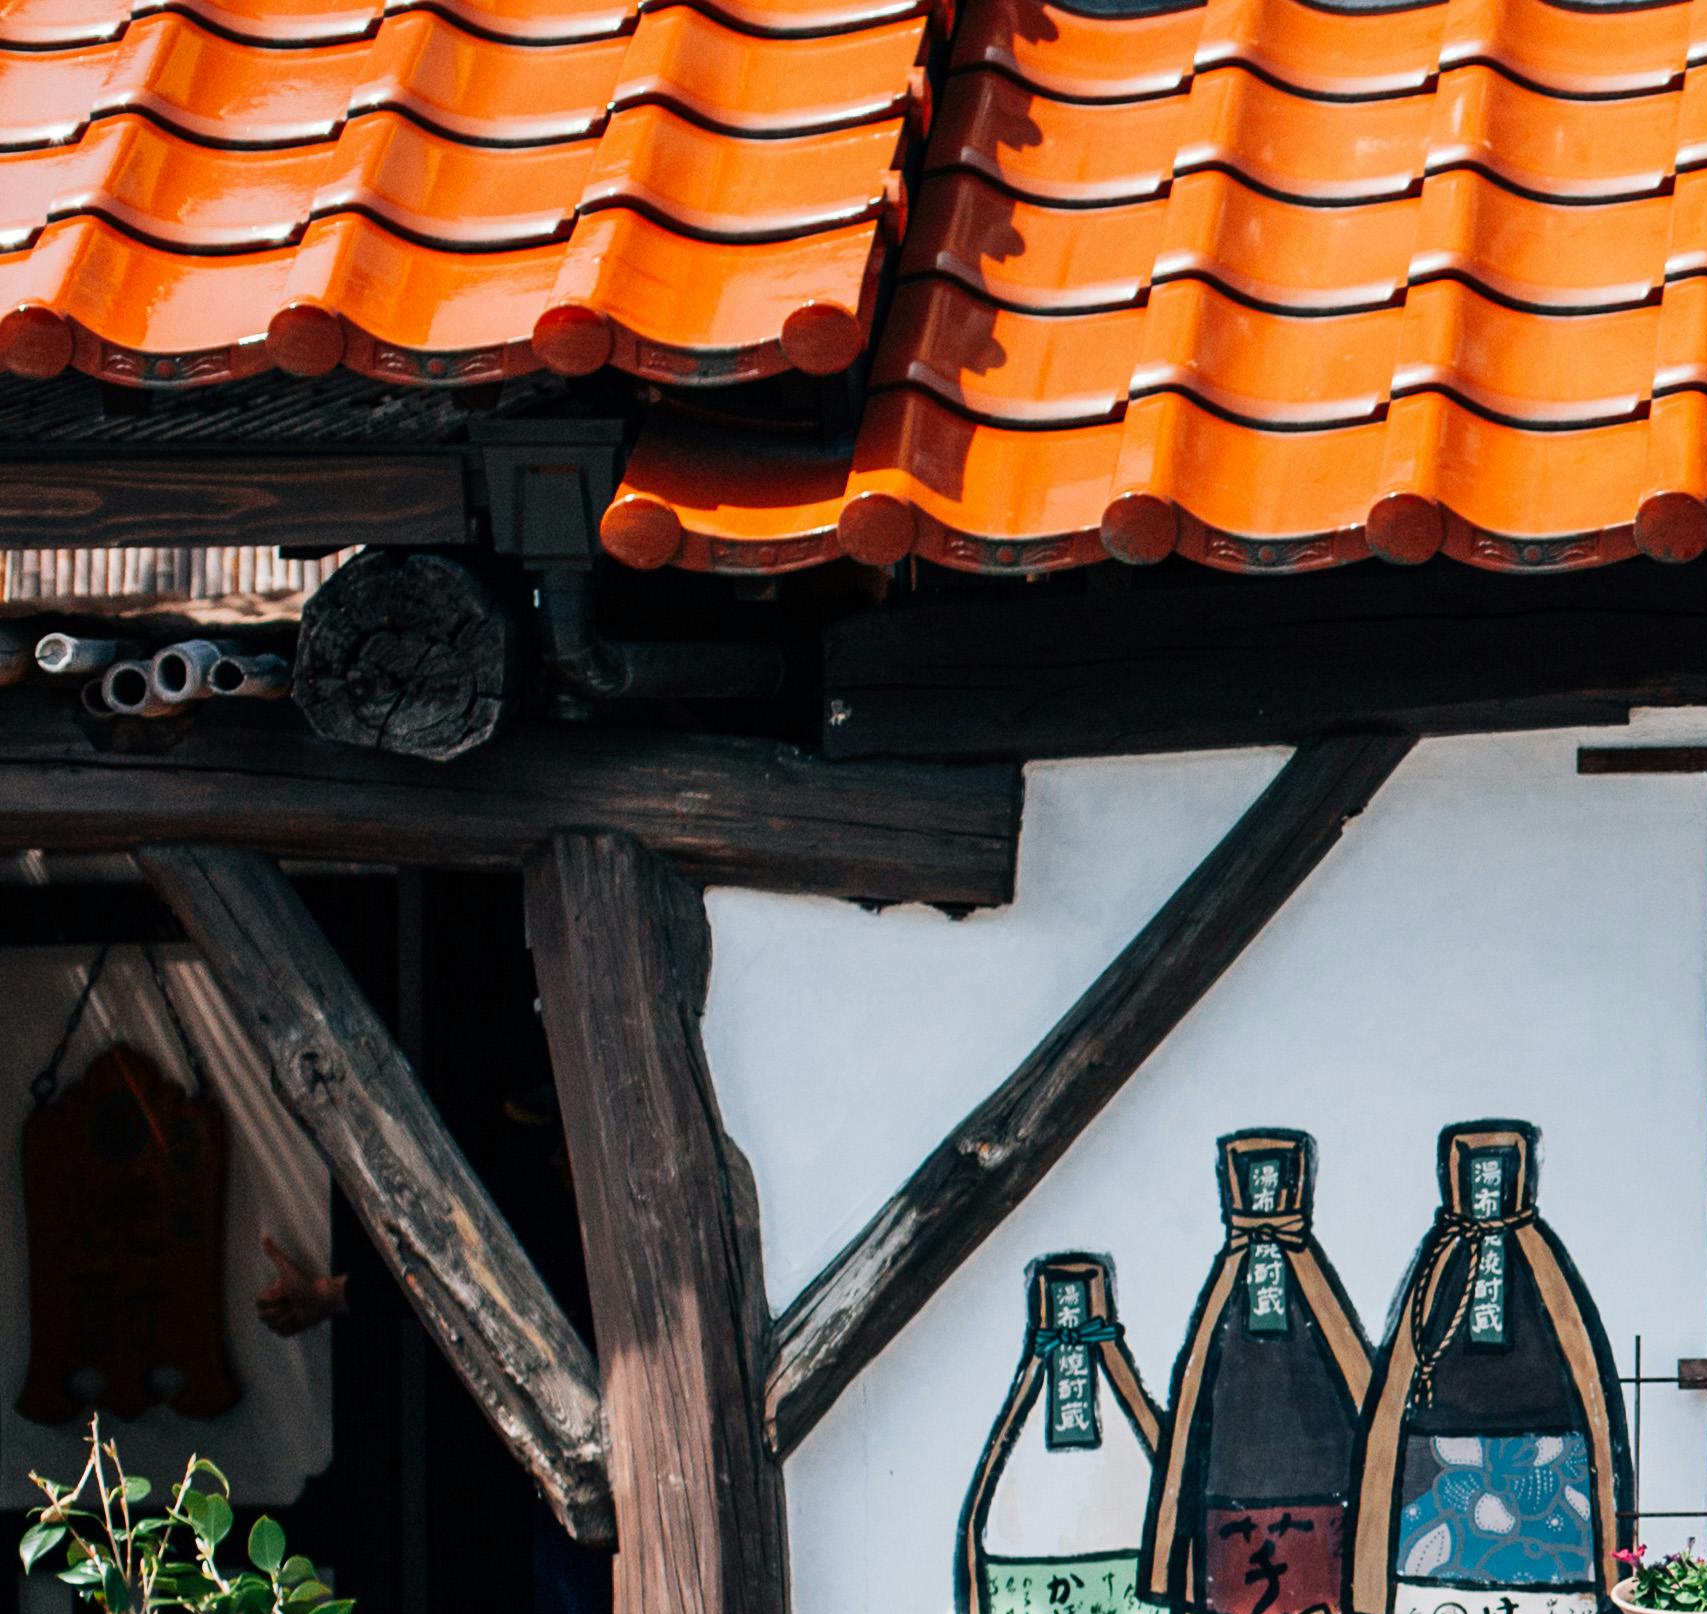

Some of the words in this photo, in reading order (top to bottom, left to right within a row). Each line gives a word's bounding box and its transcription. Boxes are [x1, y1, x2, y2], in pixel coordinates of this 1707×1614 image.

[1252, 1165, 1285, 1316] 湯布焼酎蔵
[1471, 1160, 1503, 1333] 湯布焼酎蔵
[1055, 1284, 1090, 1432] 湯布焼酎蔵
